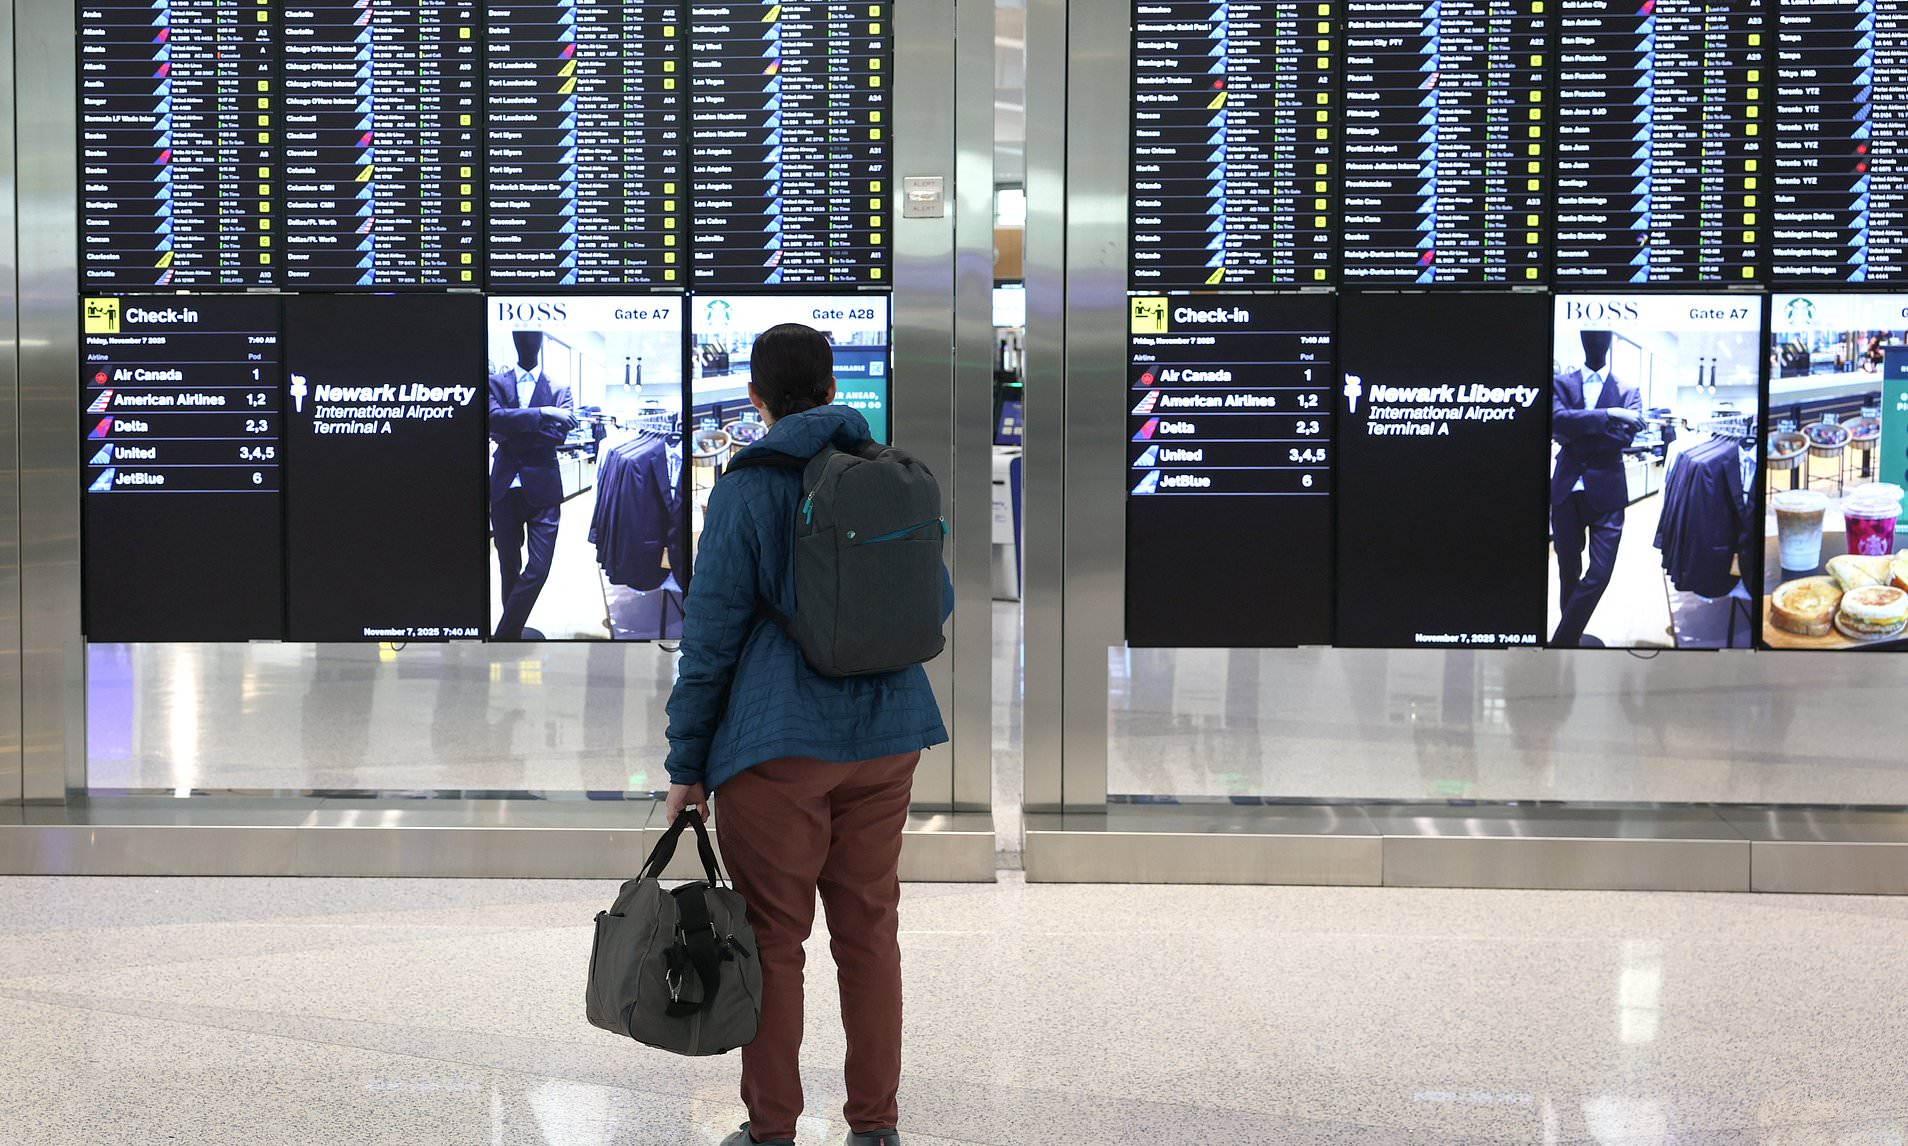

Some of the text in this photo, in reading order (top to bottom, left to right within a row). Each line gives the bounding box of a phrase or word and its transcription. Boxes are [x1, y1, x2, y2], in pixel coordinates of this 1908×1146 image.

[126, 308, 198, 323] Check-in
[499, 303, 566, 321] BOSS
[615, 308, 669, 319] Gate A7
[813, 309, 874, 319] Gate A28
[1174, 307, 1249, 323] Check-in
[1567, 301, 1638, 320] BOSS
[1690, 309, 1748, 319] Gate A7
[114, 369, 182, 381] Air Canada
[253, 369, 259, 380] 1
[1160, 370, 1231, 382] Air Canada
[1304, 369, 1311, 381] 1
[114, 394, 225, 405] American Airlines
[247, 393, 266, 407] 1,2
[314, 383, 476, 406] Newark Liberty
[846, 392, 879, 400] AHEAD,
[1160, 394, 1275, 407] American Airlines
[1369, 384, 1539, 407] Newark Liberty
[1298, 394, 1318, 408] 1,2
[315, 405, 453, 421] International Airport
[1369, 406, 1515, 422] International Airport
[115, 420, 148, 432] Delta
[246, 420, 267, 433] 2,3
[313, 421, 391, 434] Terminal A
[1160, 422, 1195, 434] Delta
[1296, 421, 1319, 435] 2,3
[1367, 421, 1449, 435] Terminal A
[115, 447, 156, 459] United
[240, 447, 275, 460] 3,4,5
[1160, 449, 1202, 461] United
[1289, 449, 1326, 463] 3,4,5
[116, 473, 164, 485] JetBlue
[253, 473, 262, 484] 6
[1160, 475, 1210, 487] JetBlue
[1302, 474, 1312, 487] 6
[364, 628, 405, 636] November
[407, 628, 415, 637] 7,
[417, 628, 439, 636] 2025
[443, 628, 463, 636] 7:40
[1415, 634, 1536, 644] November 7, 2025 7:40 AM
